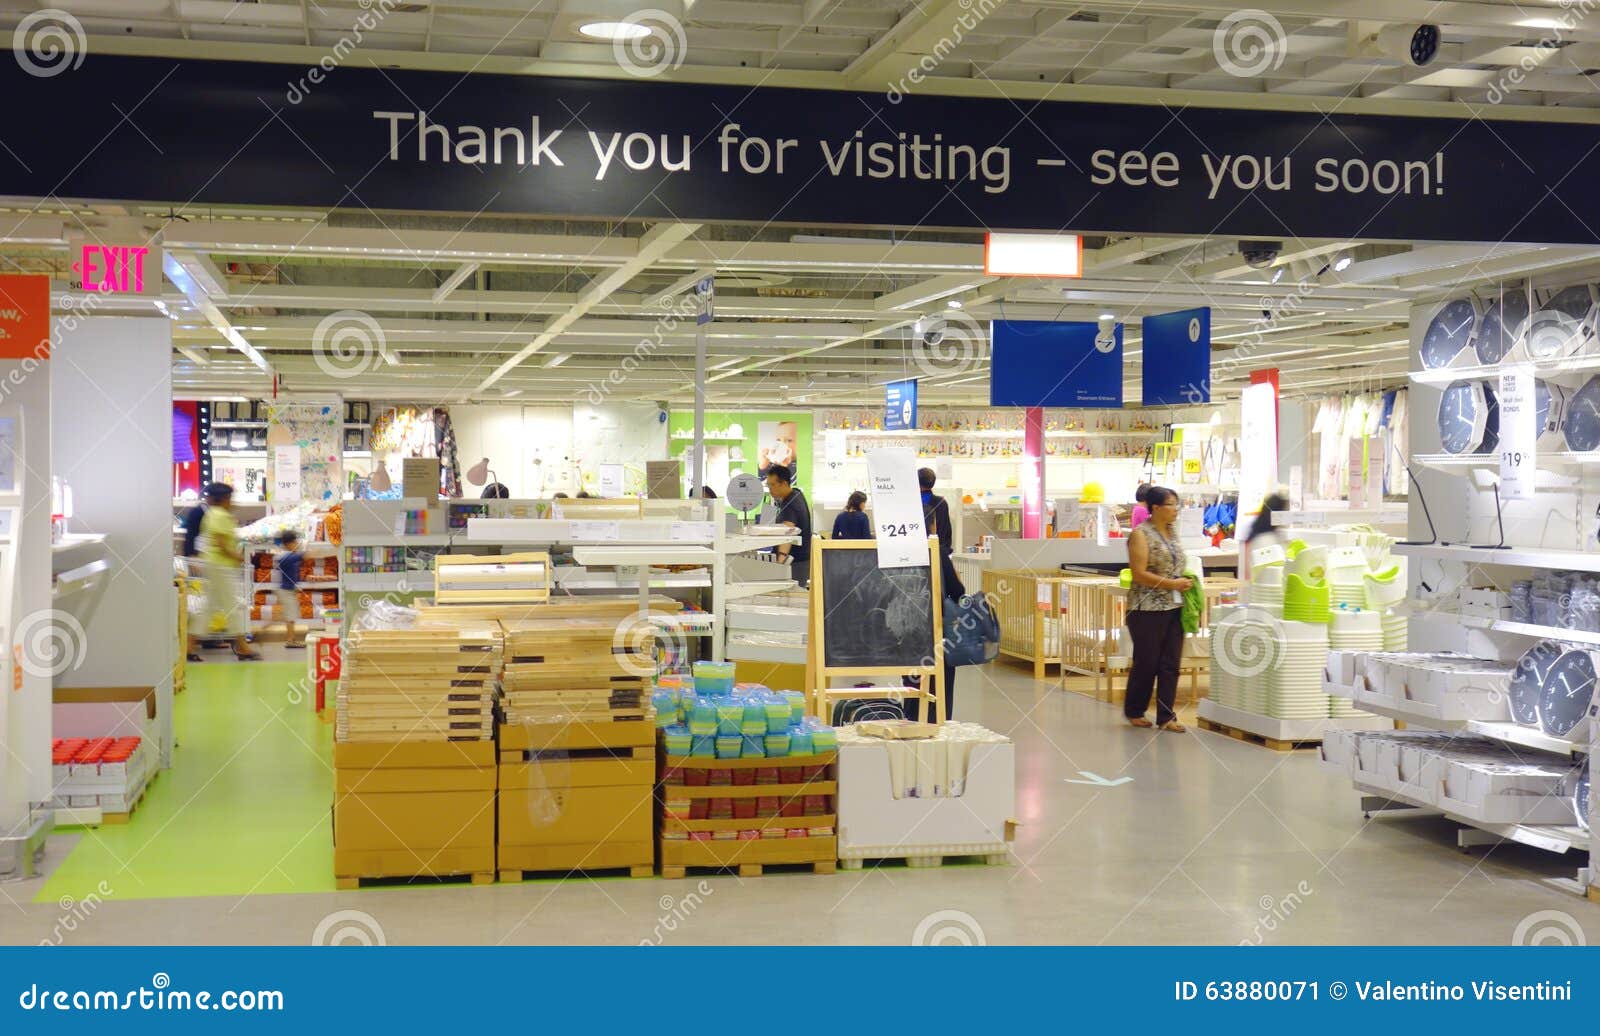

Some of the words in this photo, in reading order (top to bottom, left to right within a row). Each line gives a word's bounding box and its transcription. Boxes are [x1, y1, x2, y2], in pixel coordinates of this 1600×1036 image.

[374, 111, 563, 168] Thank
[588, 130, 690, 182] you
[719, 123, 798, 175] for
[820, 130, 1010, 194] visiting
[1090, 150, 1180, 187] see
[1202, 154, 1291, 199] you
[1314, 153, 1444, 197] soon!
[81, 245, 148, 293] EXIT
